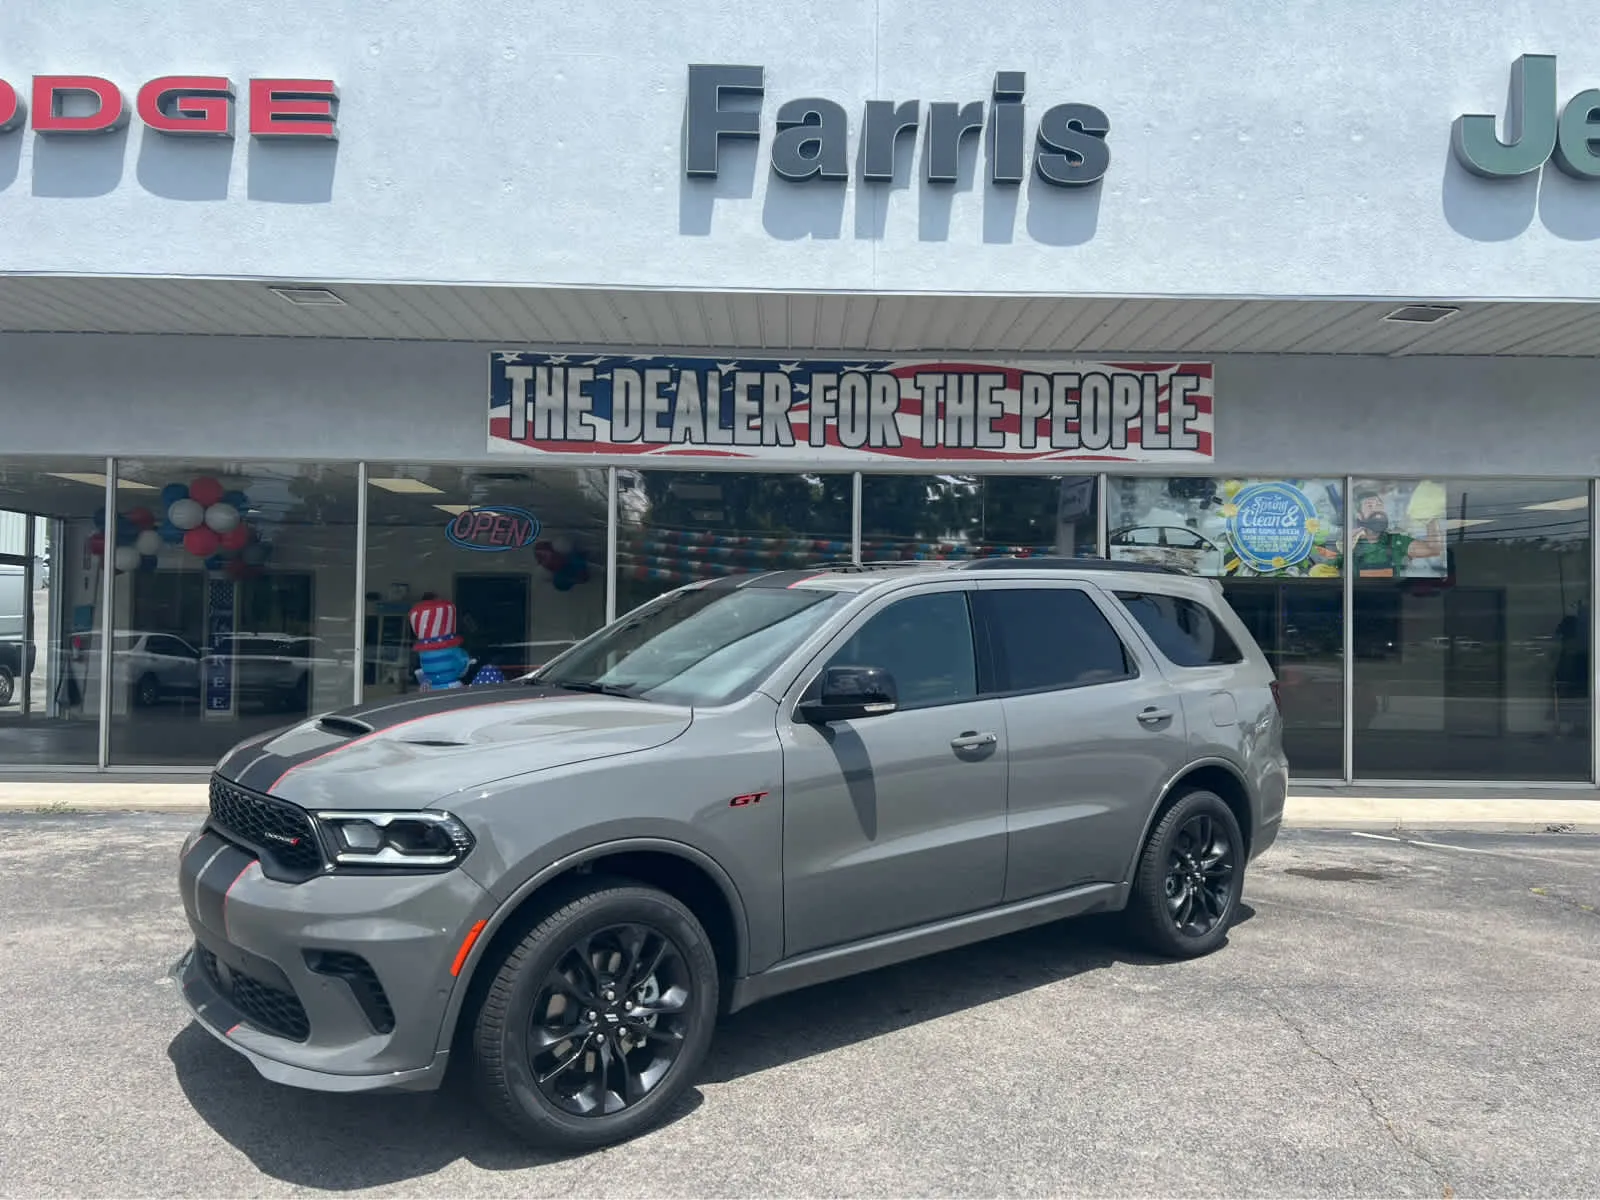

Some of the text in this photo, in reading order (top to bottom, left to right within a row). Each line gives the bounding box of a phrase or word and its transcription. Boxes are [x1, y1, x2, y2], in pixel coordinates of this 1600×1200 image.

[0, 75, 340, 141] DGE
[686, 64, 1110, 186] Farris
[504, 365, 1199, 450] THE DEALER FOR THE PEOPLE
[454, 510, 530, 547] OPEN
[1240, 507, 1281, 528] Clean
[729, 791, 769, 808] GT
